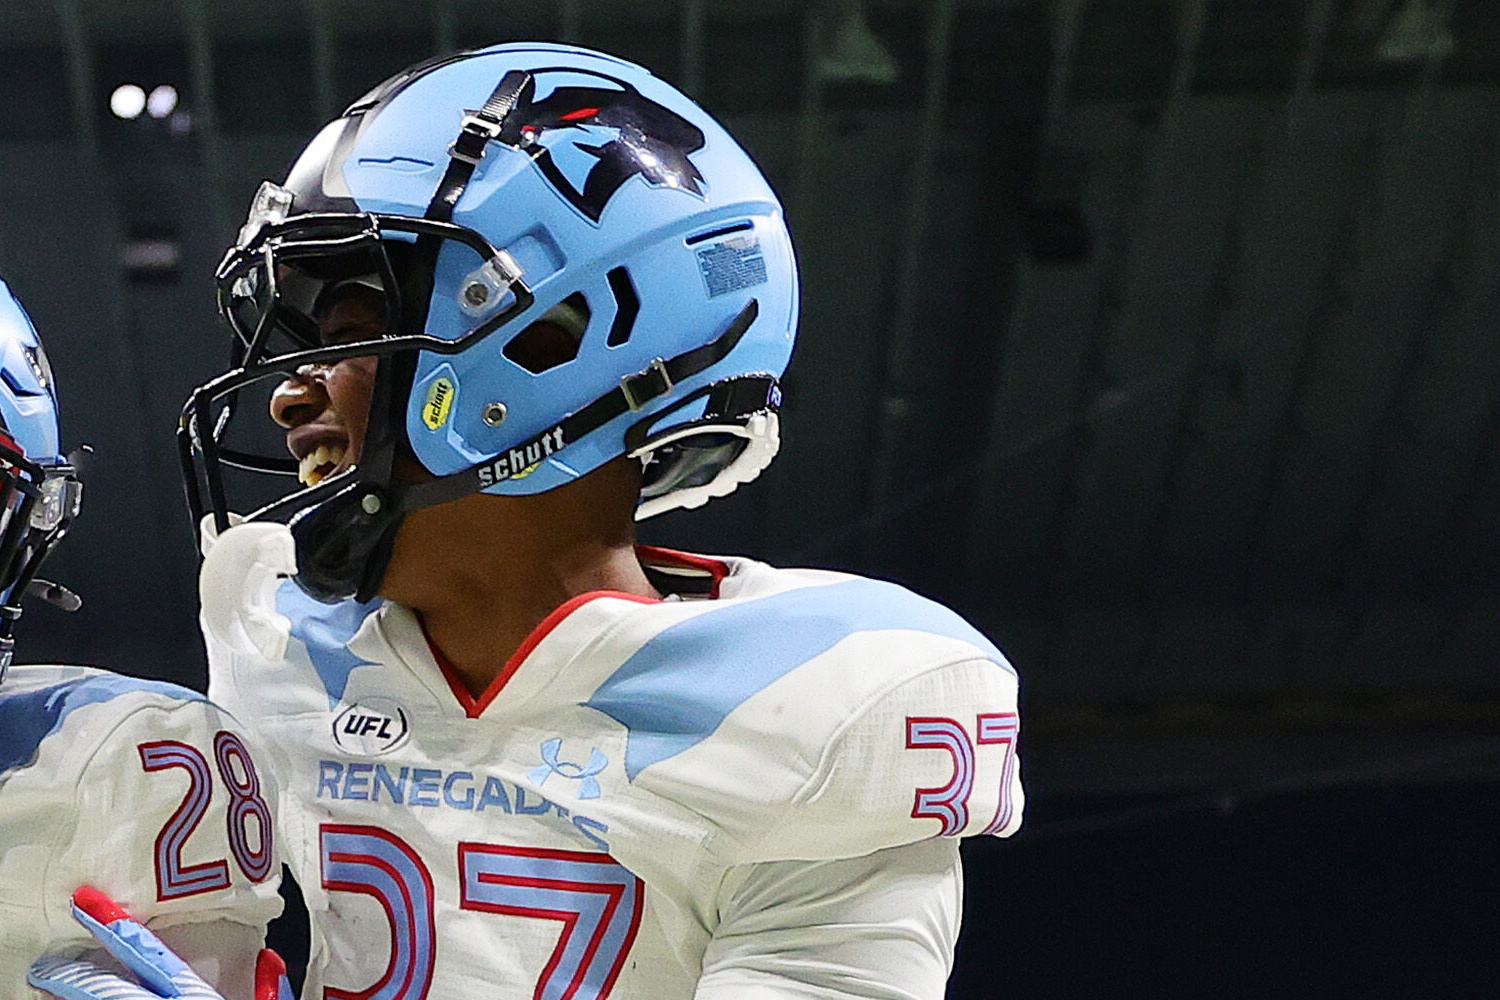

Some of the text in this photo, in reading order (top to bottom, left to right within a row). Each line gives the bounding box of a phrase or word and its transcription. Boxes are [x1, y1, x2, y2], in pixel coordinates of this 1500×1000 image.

[430, 382, 449, 425] schutt
[478, 426, 565, 487] schutt
[344, 714, 393, 740] UFL
[317, 760, 609, 851] RENEGADS
[905, 712, 1017, 836] 37
[137, 730, 273, 902] 28
